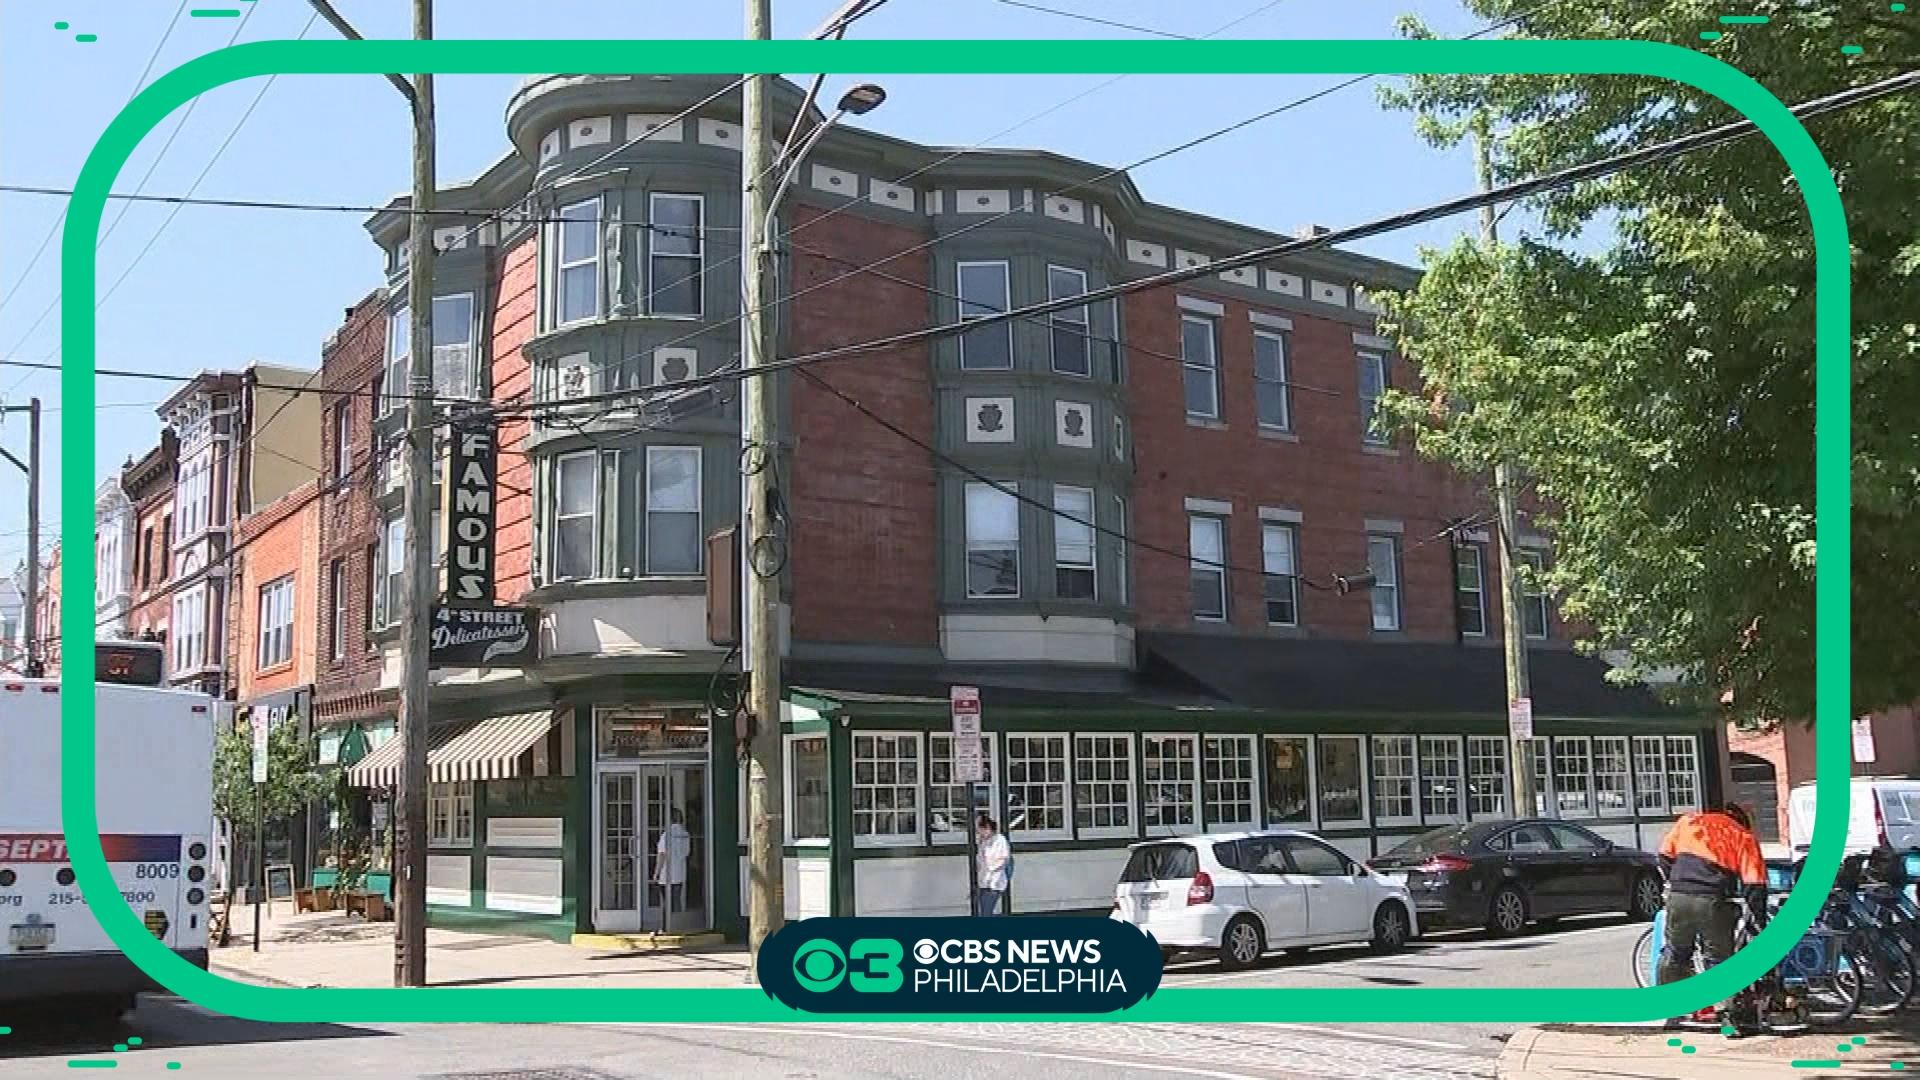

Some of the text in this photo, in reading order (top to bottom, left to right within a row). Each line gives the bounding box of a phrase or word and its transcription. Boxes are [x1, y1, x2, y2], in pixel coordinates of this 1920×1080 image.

[455, 433, 490, 599] FAMOUS
[459, 610, 525, 625] STREET
[432, 624, 527, 649] Delicatessen
[0, 839, 69, 859] SEPT
[135, 863, 180, 879] 8009
